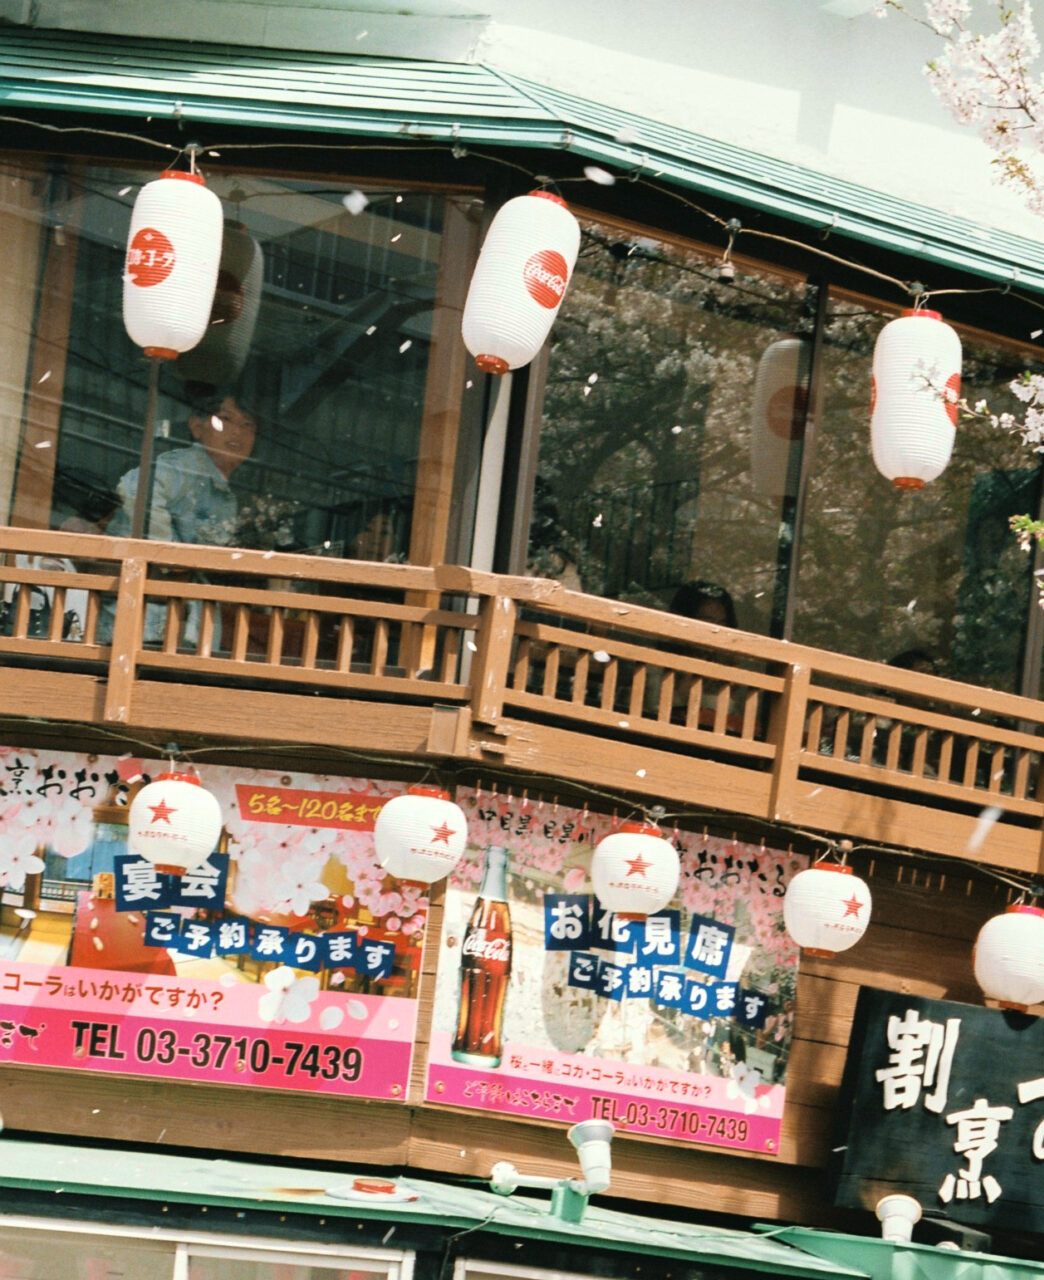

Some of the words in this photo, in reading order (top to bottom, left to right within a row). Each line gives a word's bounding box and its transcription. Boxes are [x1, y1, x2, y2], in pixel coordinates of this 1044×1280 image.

[122, 861, 222, 902] 宴会
[150, 915, 391, 971] ご予約承ります
[549, 902, 734, 967] お花見席
[572, 956, 765, 1020] ご予約承ります
[72, 1021, 124, 1059] TEL
[137, 1028, 362, 1082] 03-3710-7439
